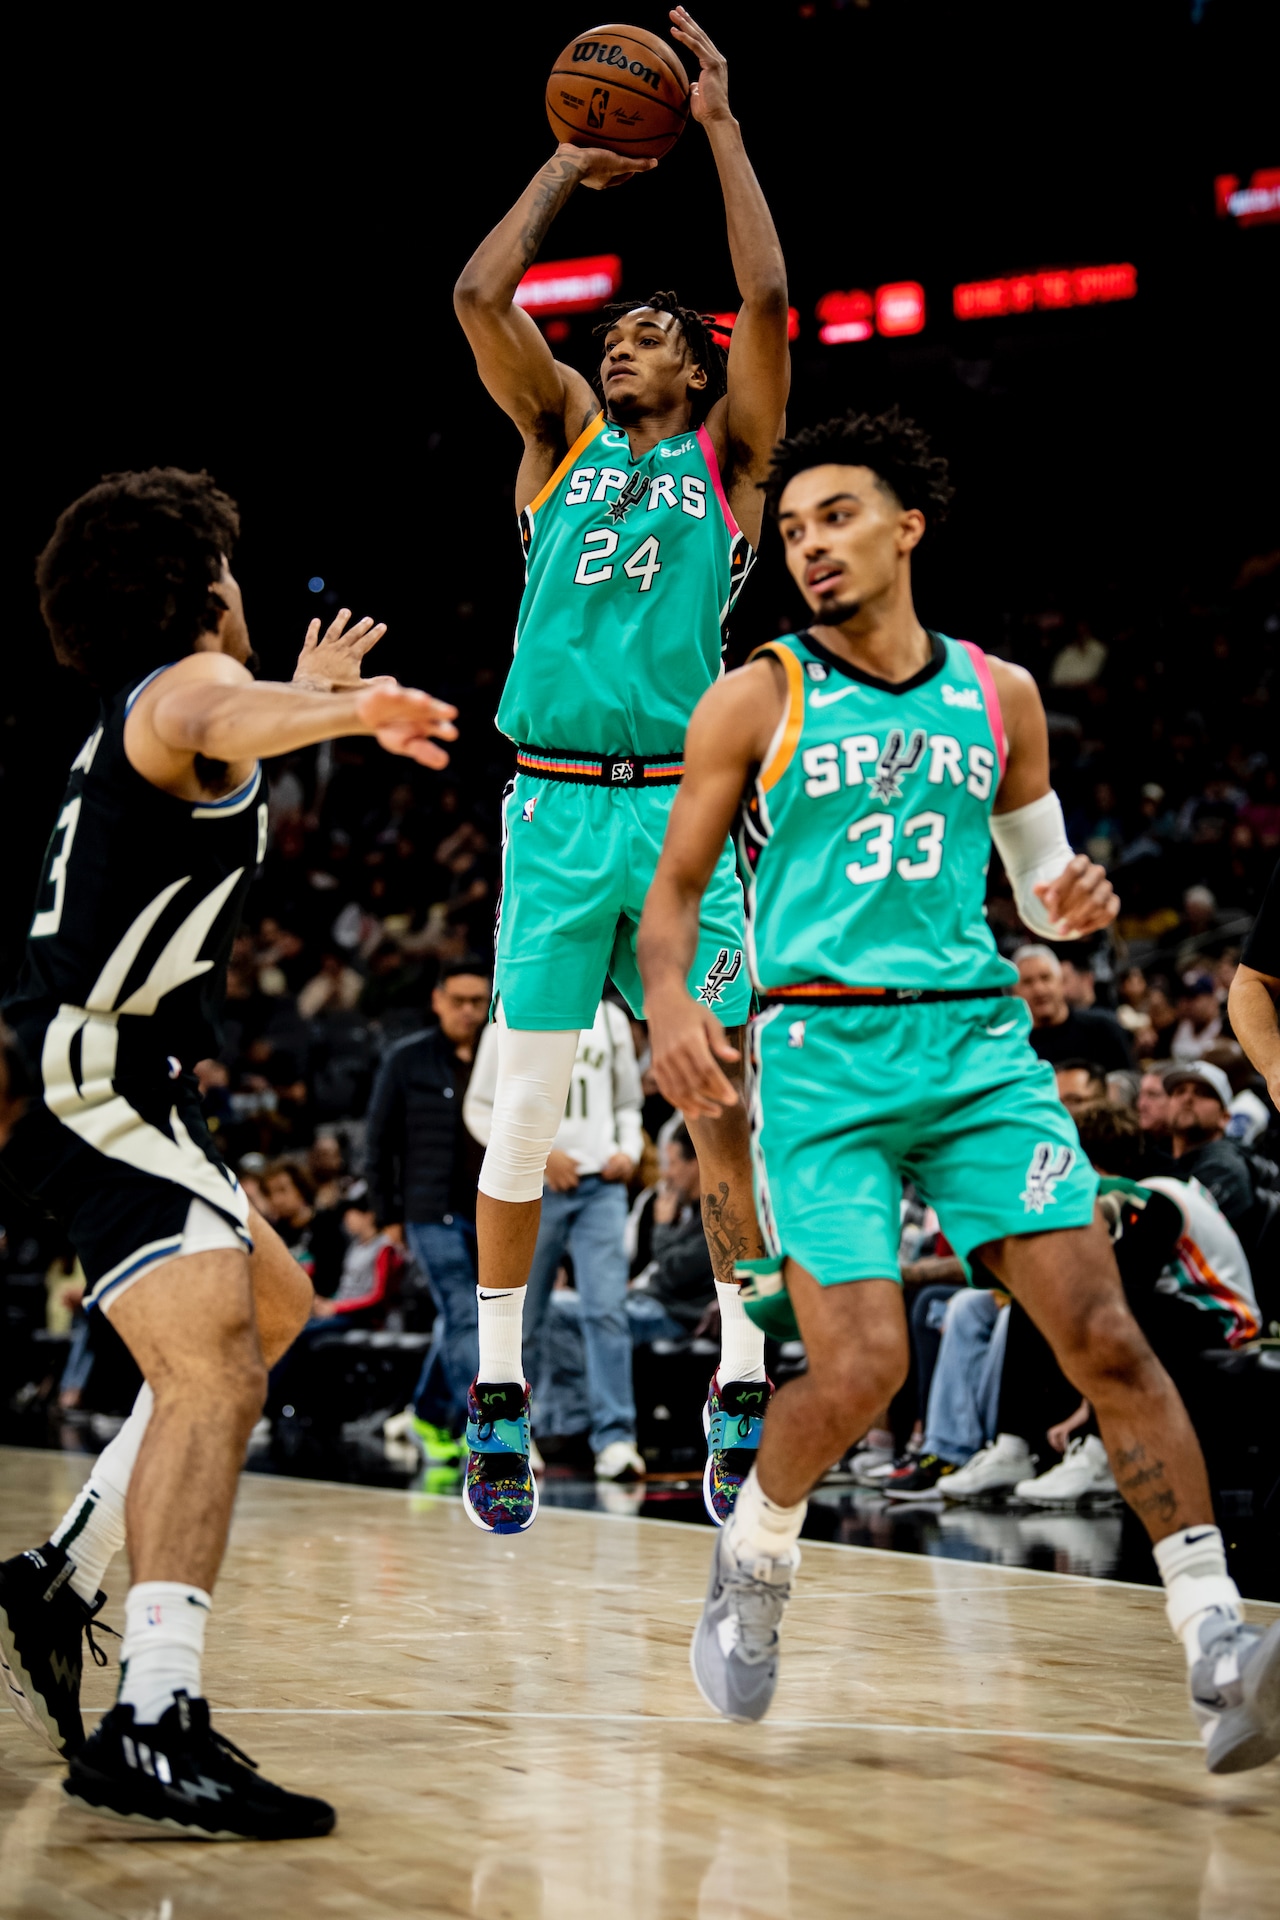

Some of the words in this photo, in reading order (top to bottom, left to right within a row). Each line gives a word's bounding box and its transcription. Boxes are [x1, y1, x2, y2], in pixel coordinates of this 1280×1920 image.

[571, 41, 661, 91] Wilson
[660, 439, 695, 458] Self.
[565, 466, 707, 525] SPURS
[573, 528, 662, 592] 24
[802, 728, 994, 805] SPURS
[844, 809, 946, 886] 33
